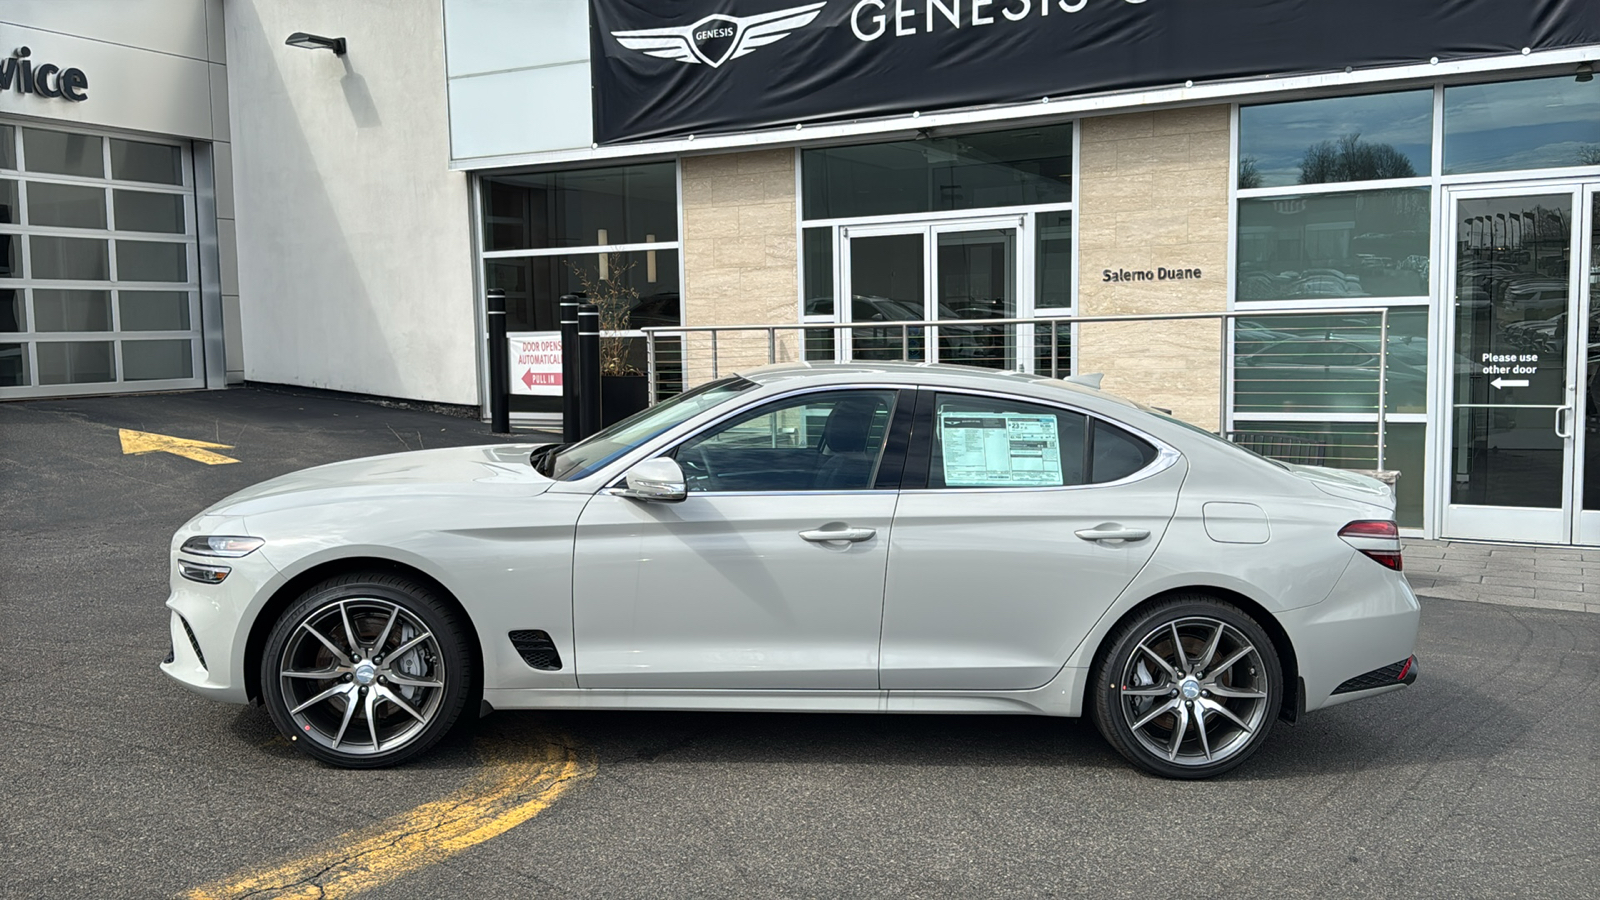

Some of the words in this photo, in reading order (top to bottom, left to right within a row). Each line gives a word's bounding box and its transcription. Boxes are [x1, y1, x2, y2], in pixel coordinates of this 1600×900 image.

[695, 27, 734, 40] GENESIS
[1102, 268, 1154, 282] Salerno
[1157, 267, 1202, 280] Duane
[523, 342, 540, 352] DOOR
[541, 340, 562, 352] OPENS
[1482, 353, 1517, 362] Please
[1519, 354, 1538, 362] use
[1482, 365, 1511, 374] other
[1512, 364, 1537, 374] door
[532, 375, 547, 384] PULL
[548, 375, 555, 384] IN
